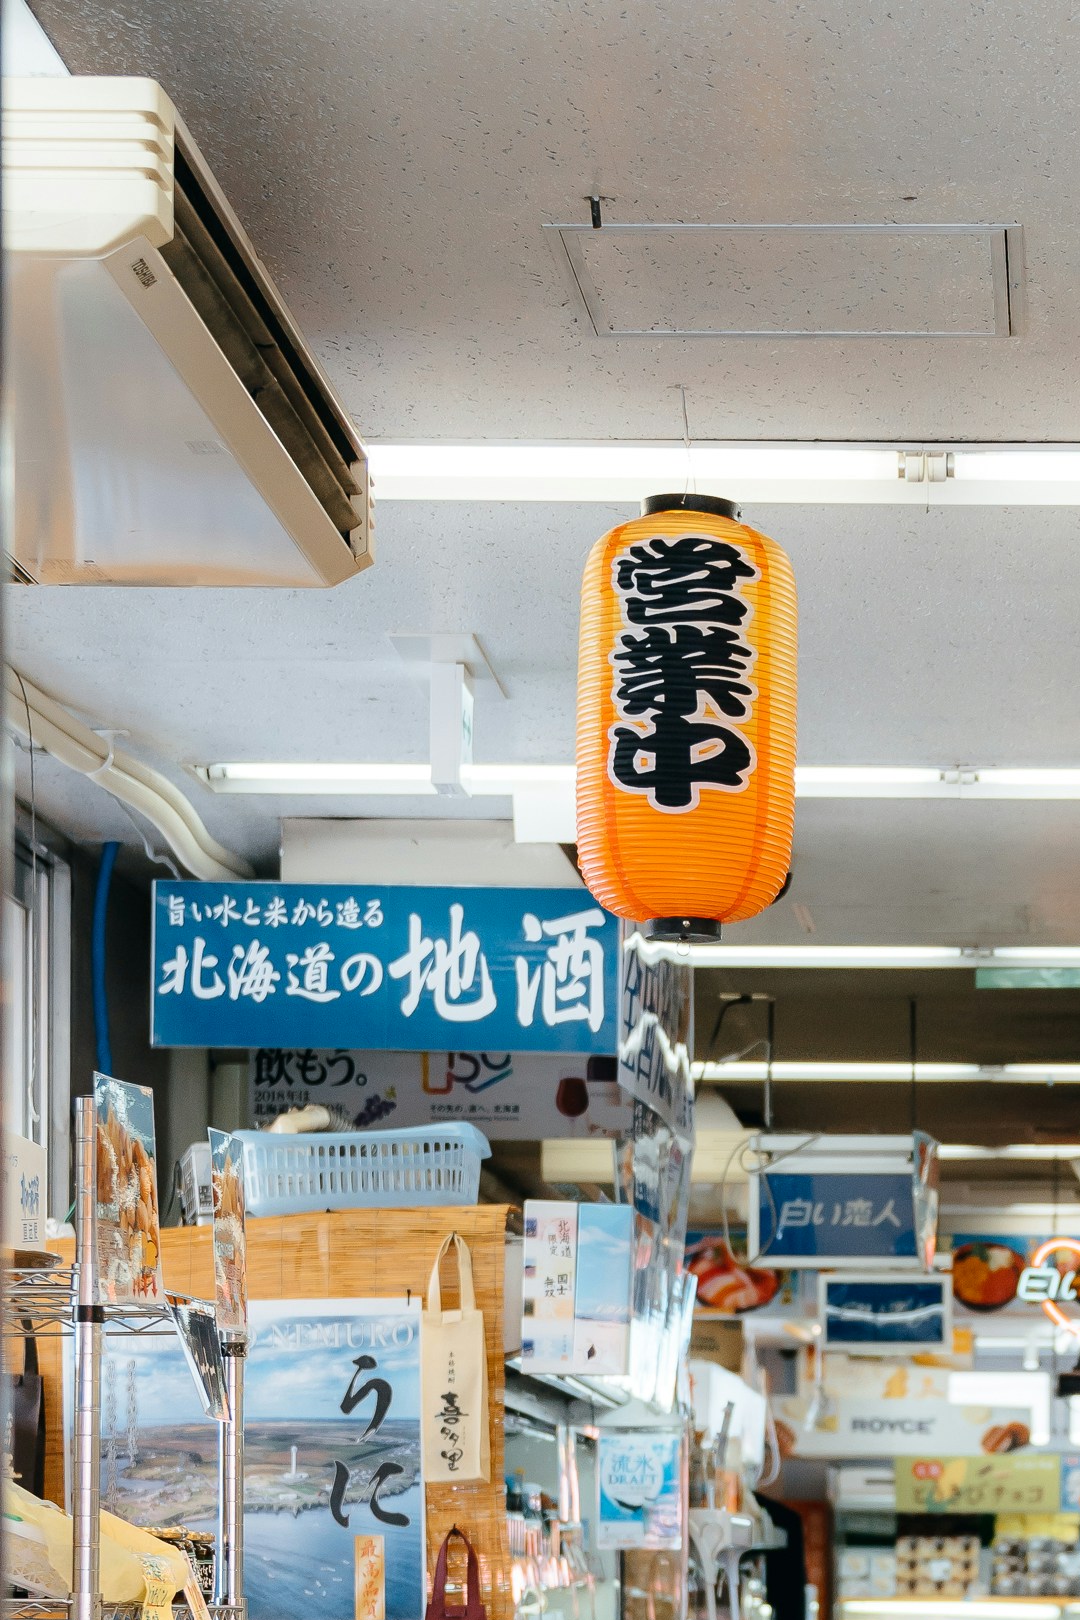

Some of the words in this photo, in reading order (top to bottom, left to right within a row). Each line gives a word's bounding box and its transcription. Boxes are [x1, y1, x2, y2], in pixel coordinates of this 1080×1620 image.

[131, 258, 157, 290] TOSHIBA
[612, 536, 759, 811] 営業中
[168, 894, 384, 929] 旨い水と米から造る
[158, 903, 606, 1032] 北海道の地酒
[778, 1197, 901, 1231] 白い恋人
[271, 1322, 414, 1348] NEMURO
[331, 1355, 410, 1529] うに
[608, 1473, 657, 1487] DRAFT
